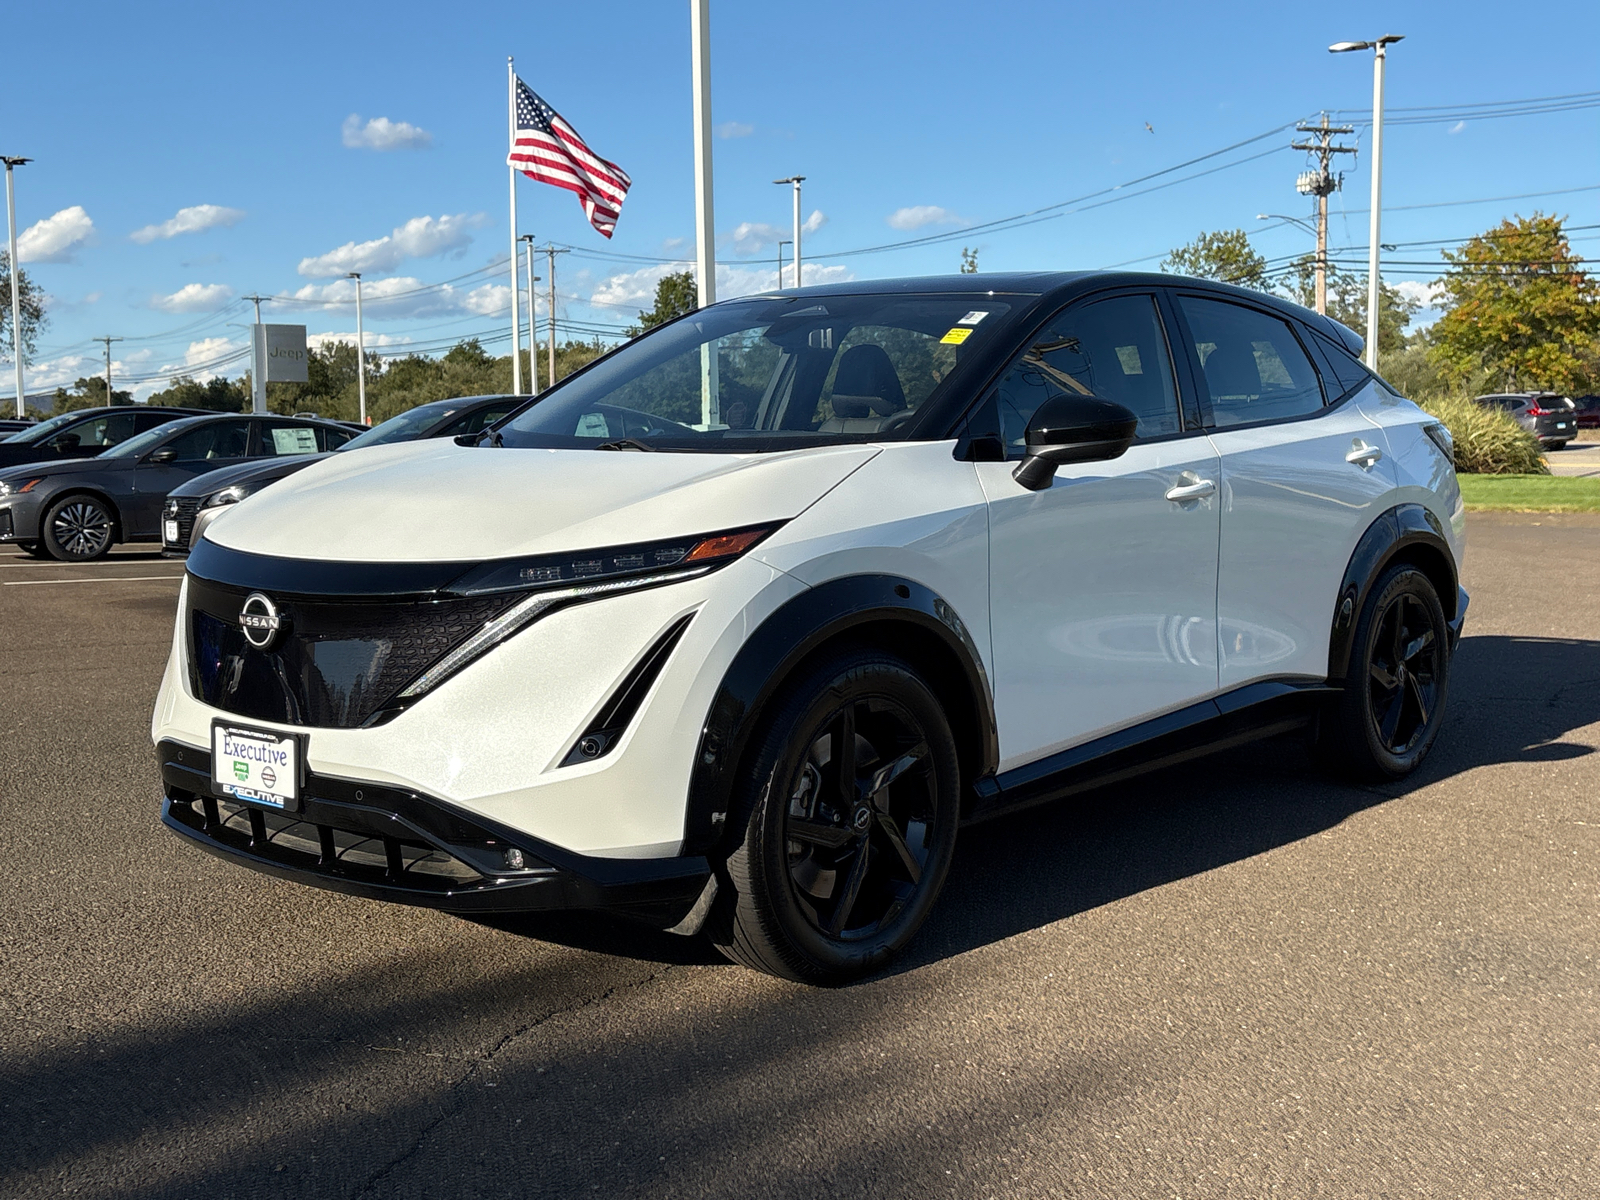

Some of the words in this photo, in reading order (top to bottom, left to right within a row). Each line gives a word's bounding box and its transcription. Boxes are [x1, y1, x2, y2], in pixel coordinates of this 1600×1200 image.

[269, 346, 303, 361] Jeep
[239, 614, 279, 629] NISSAN
[223, 734, 287, 766] Executive
[235, 762, 247, 772] Jeep
[222, 784, 284, 805] EXECUTIVE
